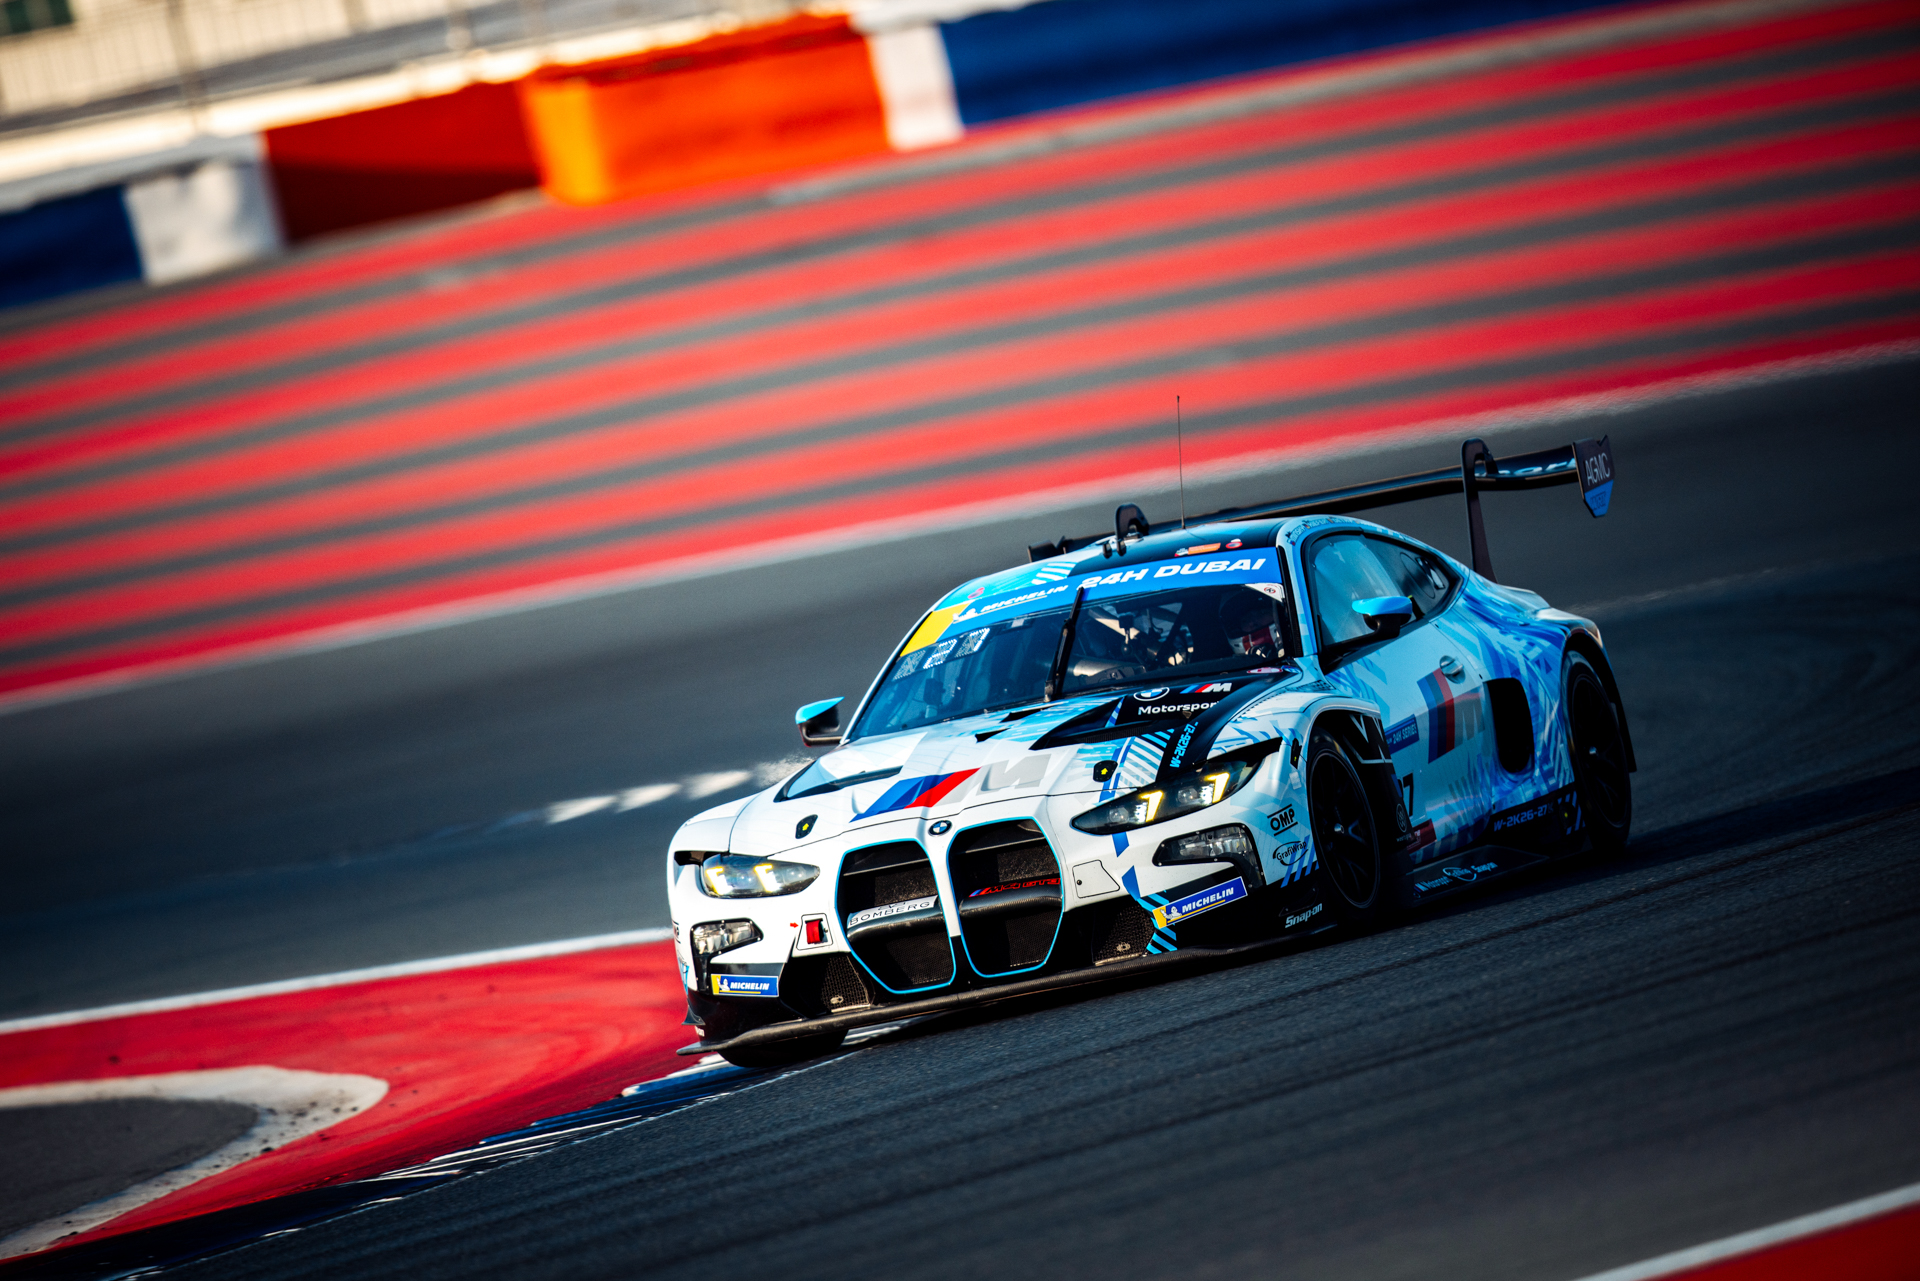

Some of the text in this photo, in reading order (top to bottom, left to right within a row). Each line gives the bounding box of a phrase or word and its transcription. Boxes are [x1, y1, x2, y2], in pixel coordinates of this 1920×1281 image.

[1585, 452, 1611, 486] AGMC
[1076, 558, 1267, 591] 24H DUBAI
[980, 585, 1069, 613] MICHELIN
[1137, 701, 1220, 715] Motorspor
[1270, 807, 1296, 831] OMP
[1276, 840, 1308, 862] GrafiWrap
[1181, 886, 1235, 913] MICHELIN
[849, 901, 931, 926] BOMBERG
[1284, 902, 1323, 929] Snap-on
[730, 981, 770, 991] MICHELIN
